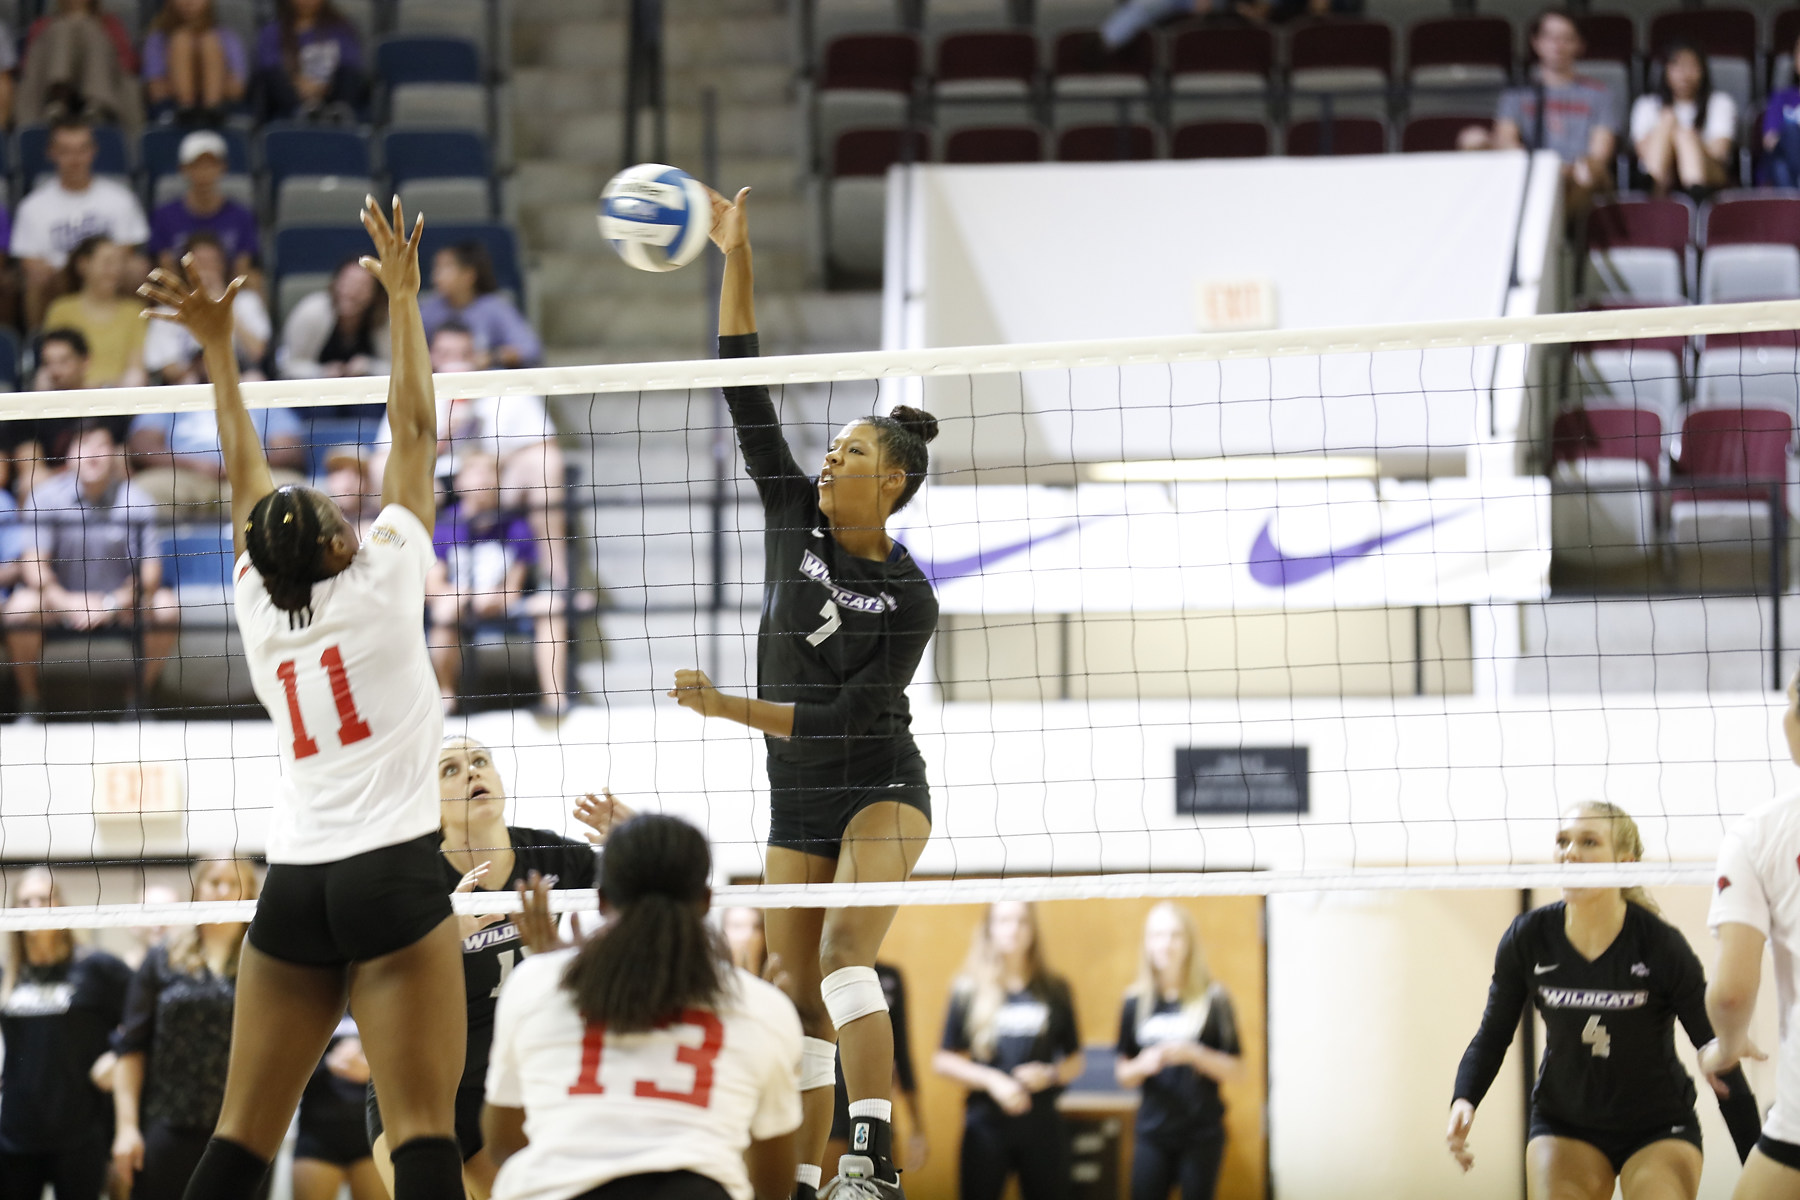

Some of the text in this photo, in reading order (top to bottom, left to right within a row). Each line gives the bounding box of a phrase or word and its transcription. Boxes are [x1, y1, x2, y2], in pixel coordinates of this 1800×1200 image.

[805, 598, 843, 648] 7
[276, 643, 373, 761] 11
[1541, 988, 1647, 1008] WILDCATS
[567, 1006, 724, 1109] 13
[1581, 1013, 1611, 1059] 4
